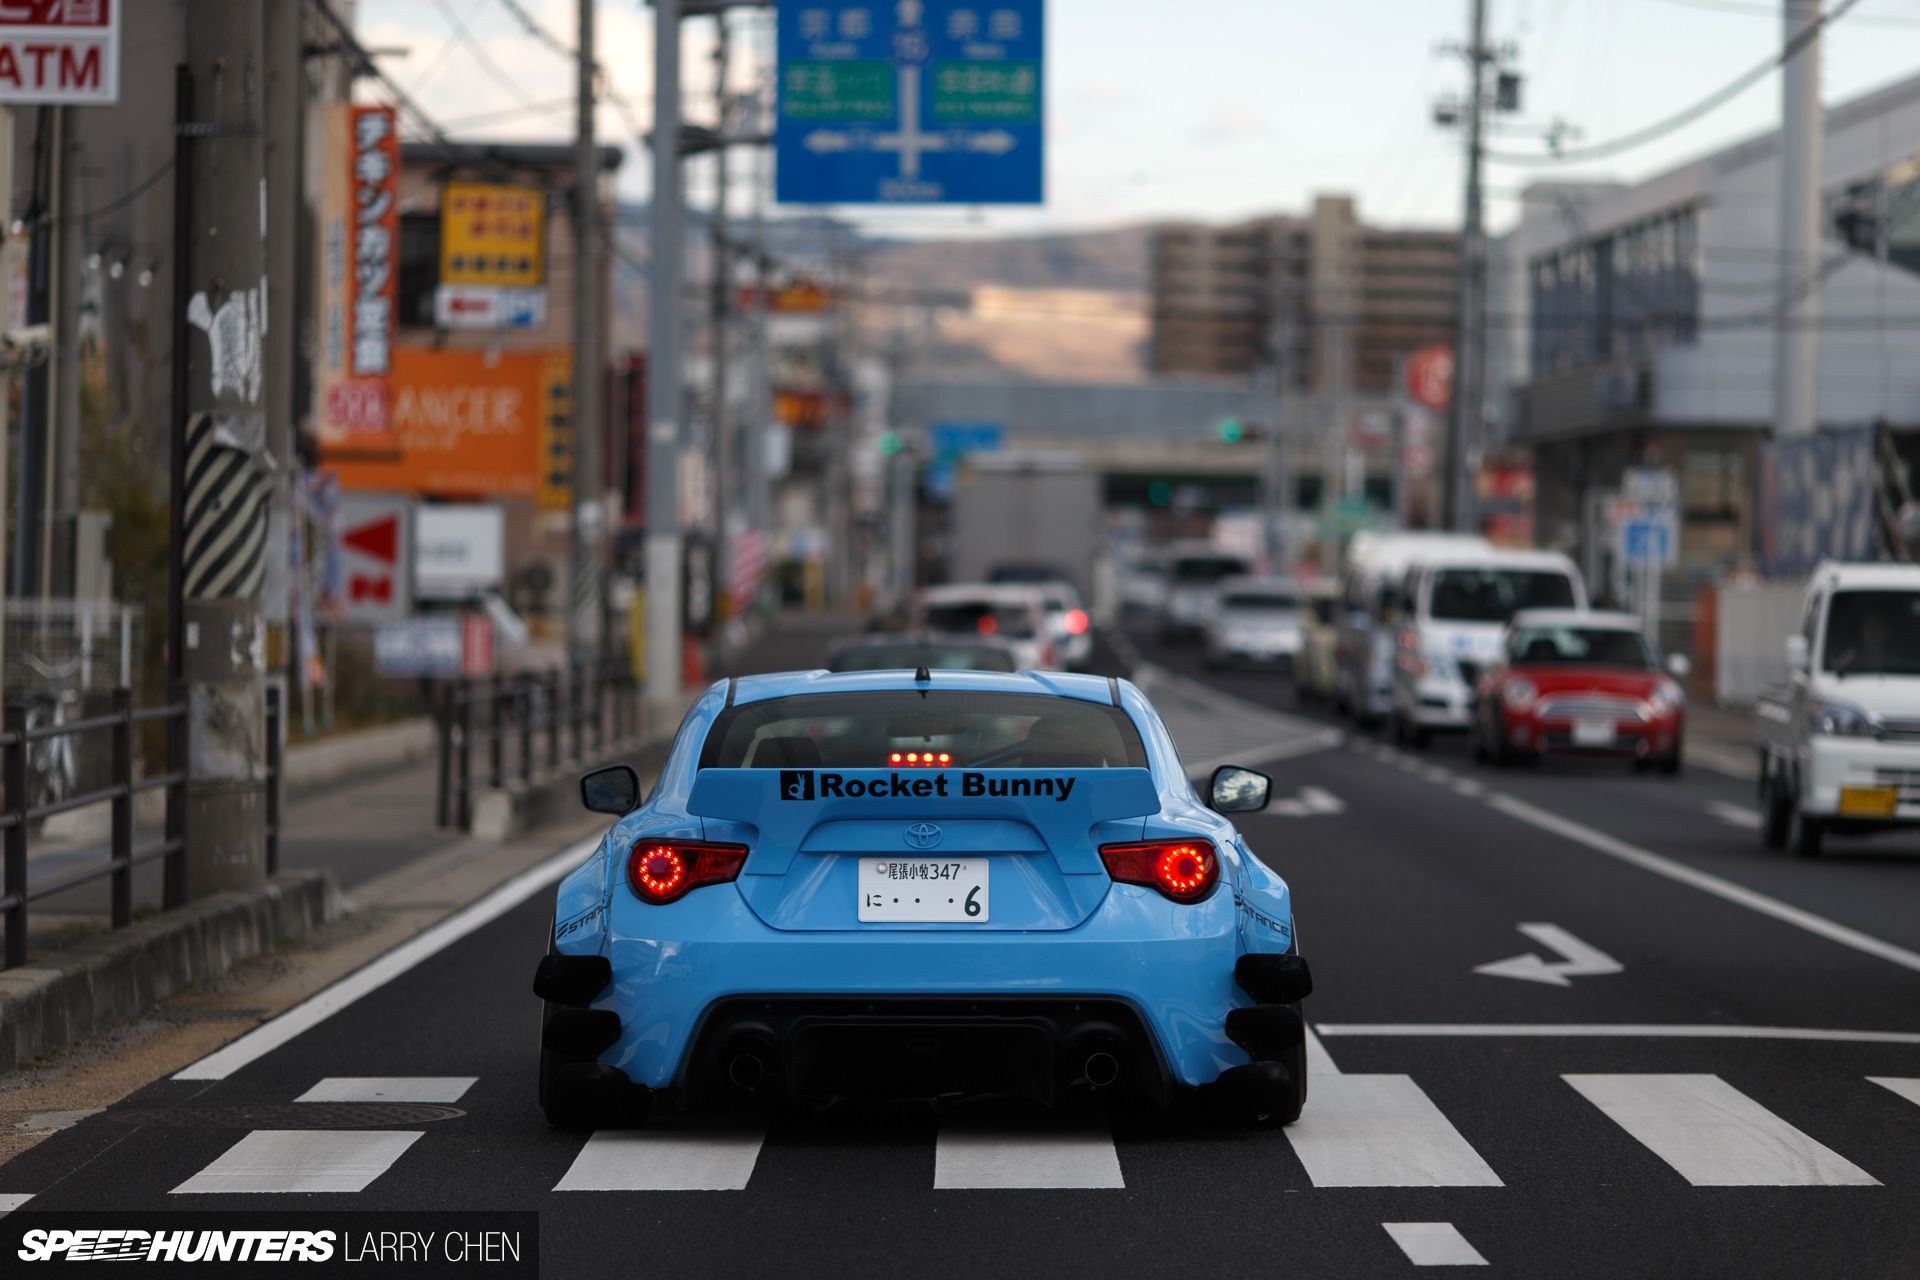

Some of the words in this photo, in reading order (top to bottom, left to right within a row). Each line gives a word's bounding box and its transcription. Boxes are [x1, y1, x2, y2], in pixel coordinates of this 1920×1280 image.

[0, 43, 102, 91] ATM
[820, 772, 949, 798] Rocket
[962, 772, 1076, 801] Bunny
[1243, 902, 1290, 938] STANCE
